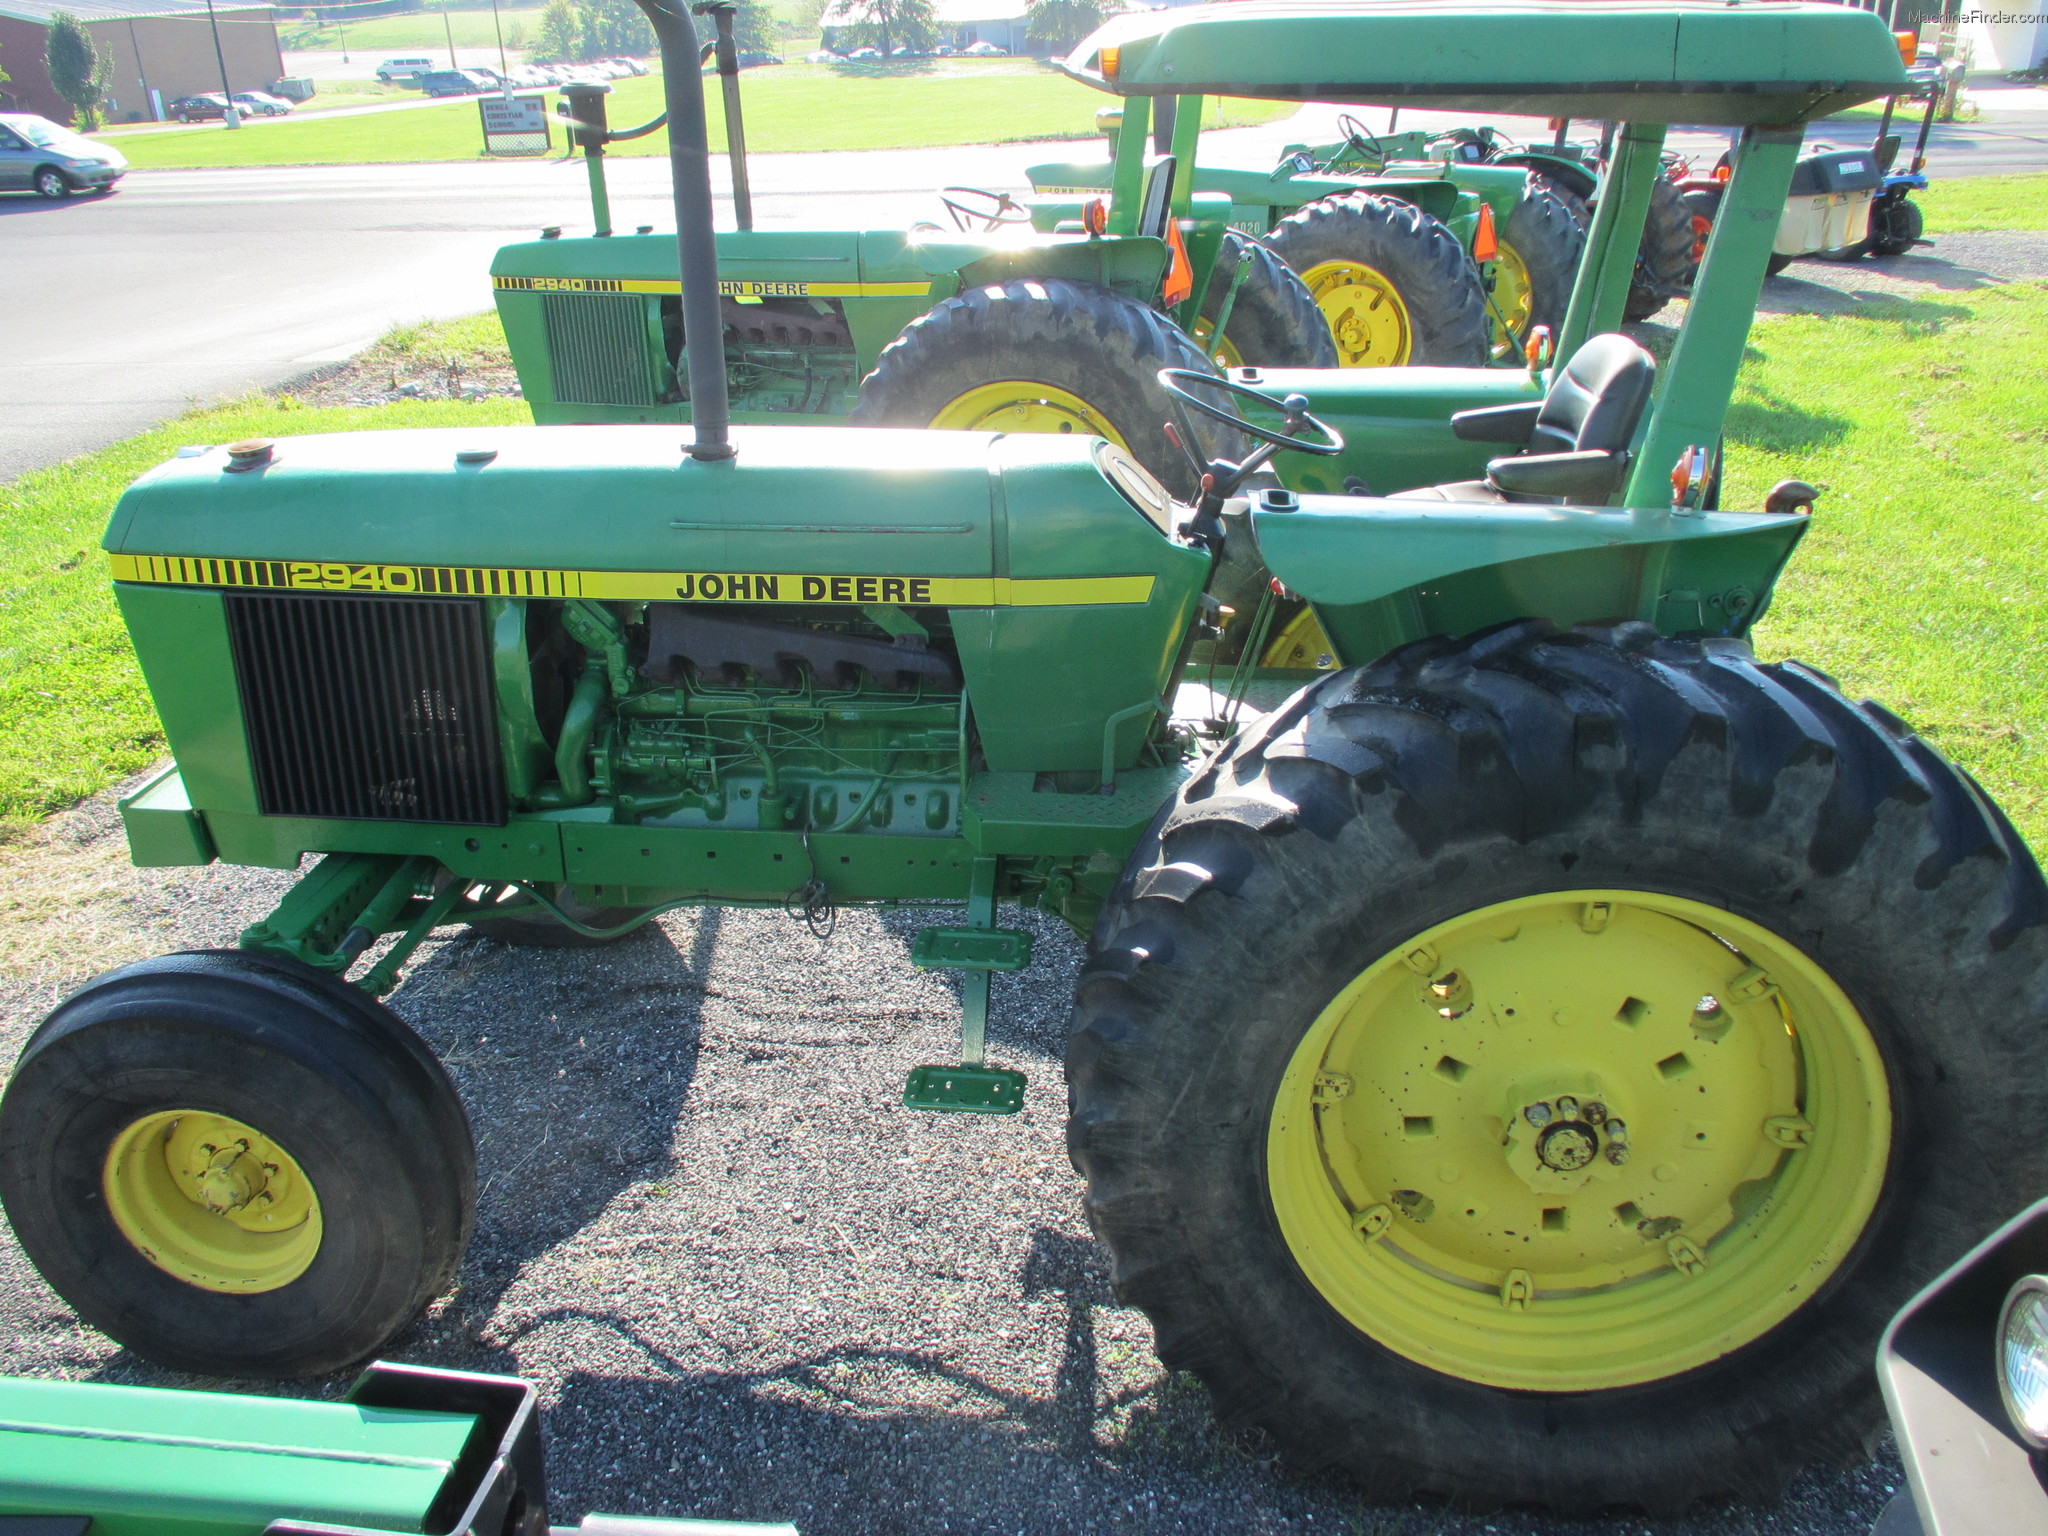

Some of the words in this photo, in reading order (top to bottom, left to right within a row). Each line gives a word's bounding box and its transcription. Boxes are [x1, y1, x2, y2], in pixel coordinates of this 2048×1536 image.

[487, 112, 523, 120] CHRISTIAN
[1233, 221, 1260, 235] 4020
[533, 278, 584, 291] 2940
[752, 282, 808, 296] DEERE
[289, 562, 416, 592] 2940
[676, 574, 779, 600] JOHN
[802, 576, 931, 603] DEERE
